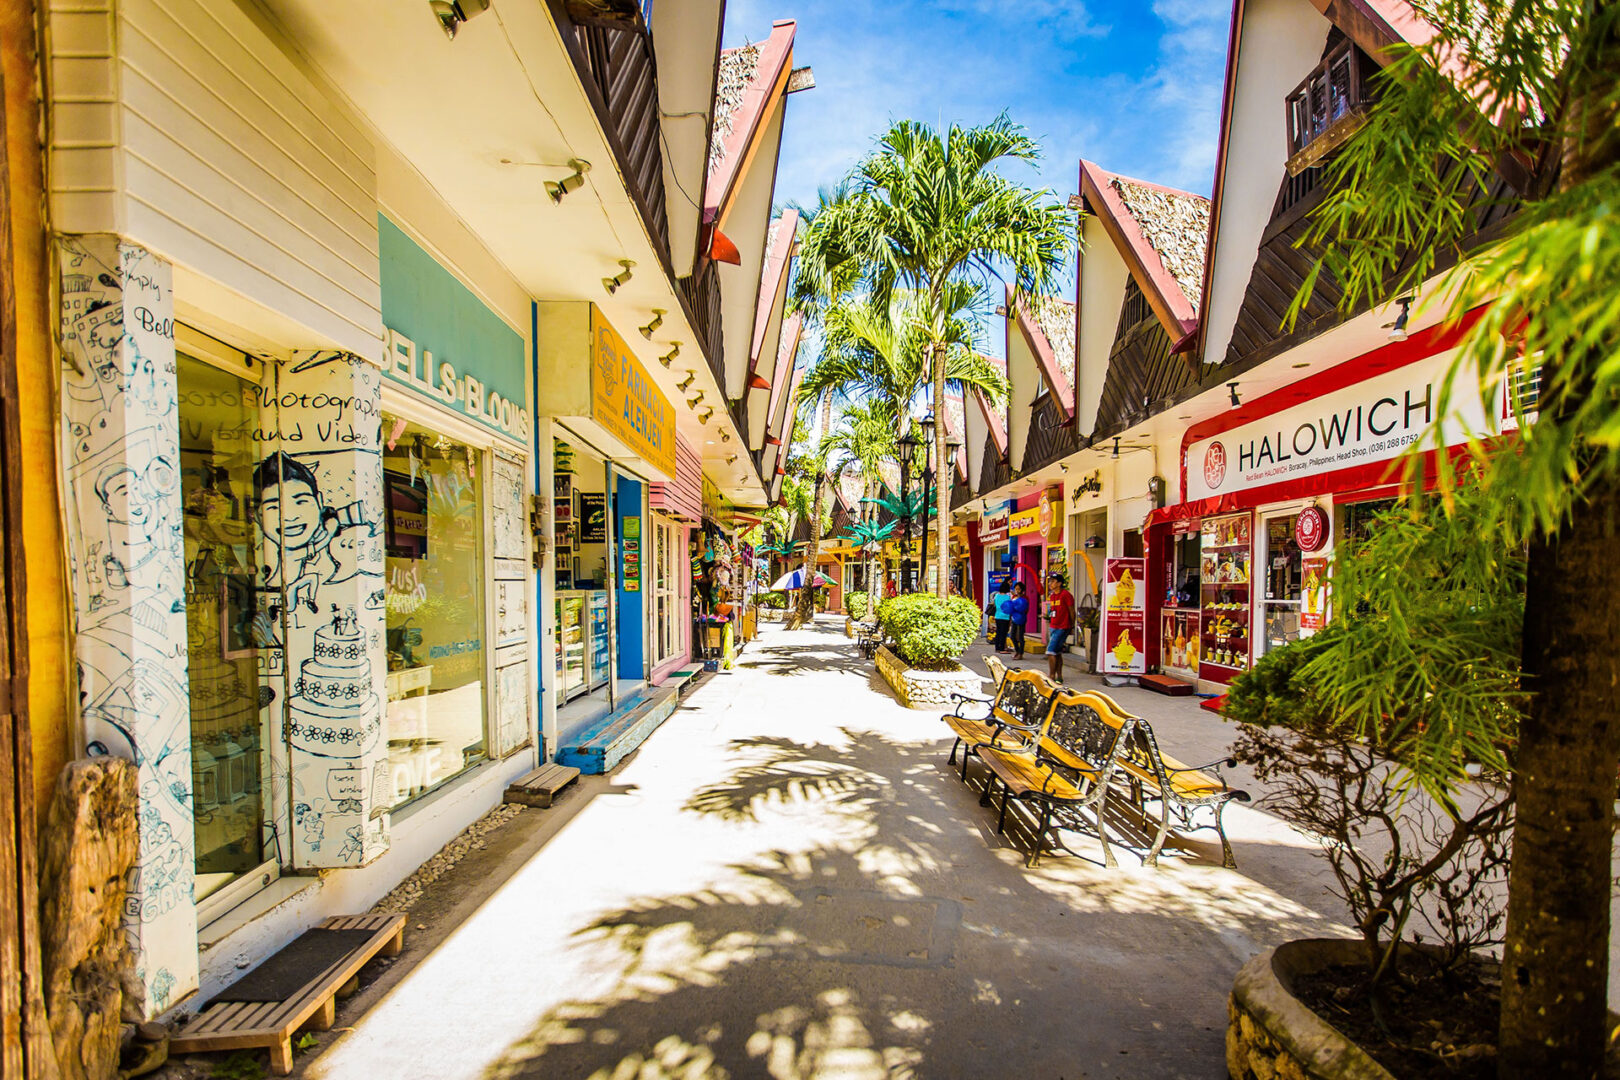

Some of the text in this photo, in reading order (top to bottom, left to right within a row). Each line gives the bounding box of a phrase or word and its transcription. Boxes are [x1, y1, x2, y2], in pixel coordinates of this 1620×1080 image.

[464, 373, 529, 441] BLOOMS
[621, 354, 665, 427] FARMACIA
[251, 421, 303, 442] and
[317, 420, 369, 446] Video
[623, 394, 662, 452] ALENJEN
[1239, 383, 1432, 473] HALOWICH
[1337, 450, 1351, 460] Head
[1368, 442, 1386, 456] (036)
[391, 564, 418, 592] JUST
